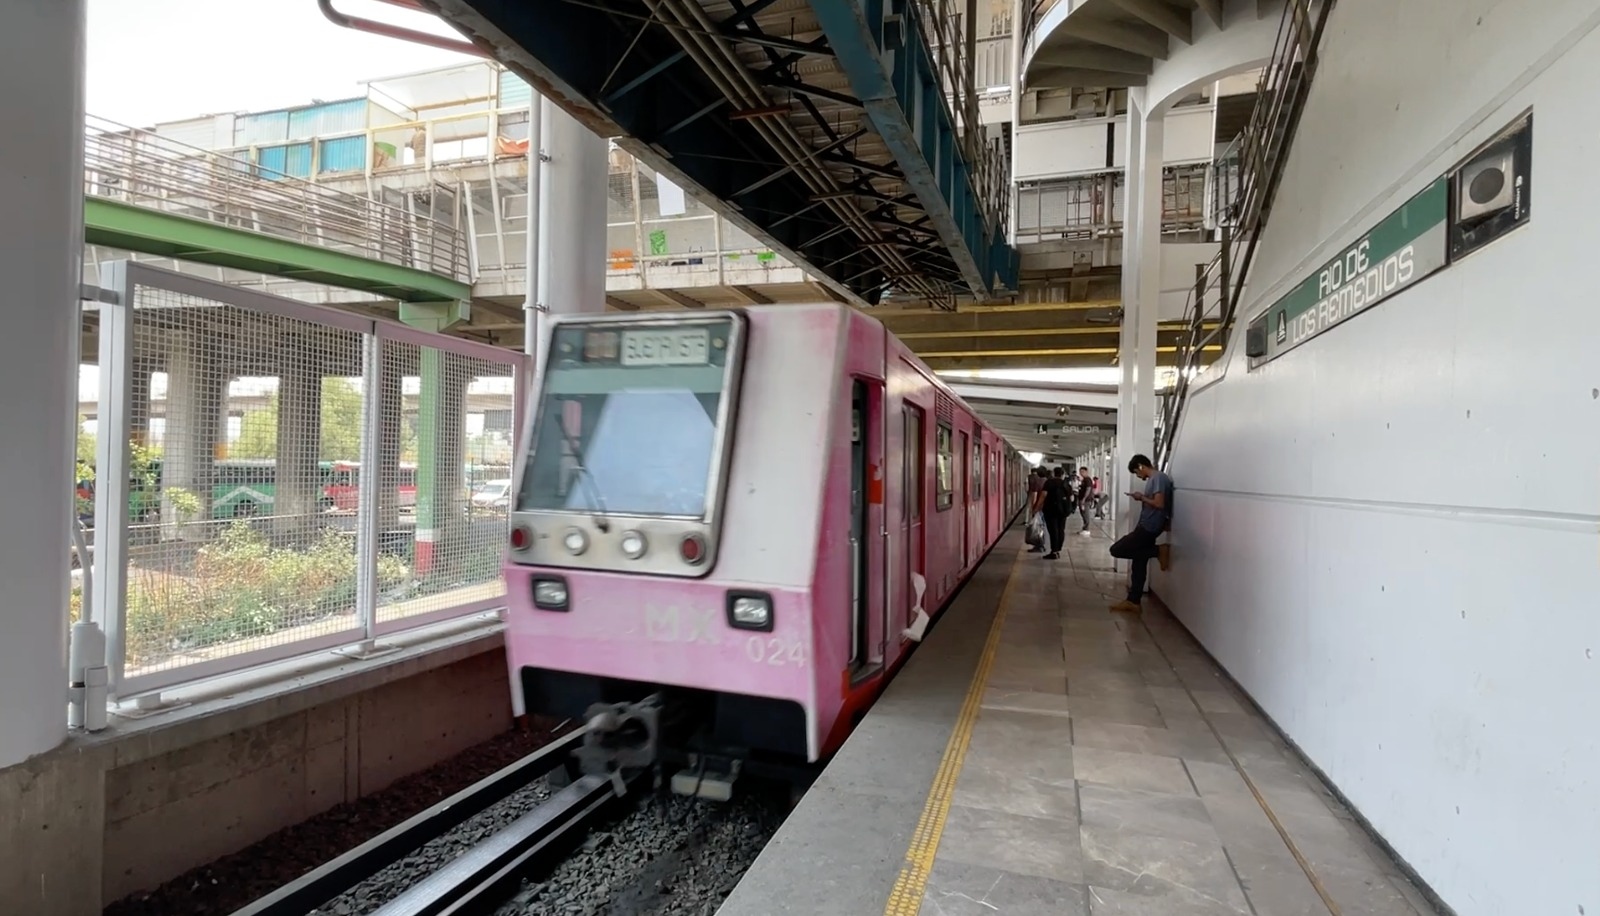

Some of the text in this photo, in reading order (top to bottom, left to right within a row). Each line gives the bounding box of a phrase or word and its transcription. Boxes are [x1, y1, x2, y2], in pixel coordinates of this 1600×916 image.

[1319, 239, 1369, 299] RIO DE
[1292, 245, 1414, 344] LOS REMEDIOS
[1062, 425, 1100, 434] SALIDA
[746, 636, 807, 667] 024
